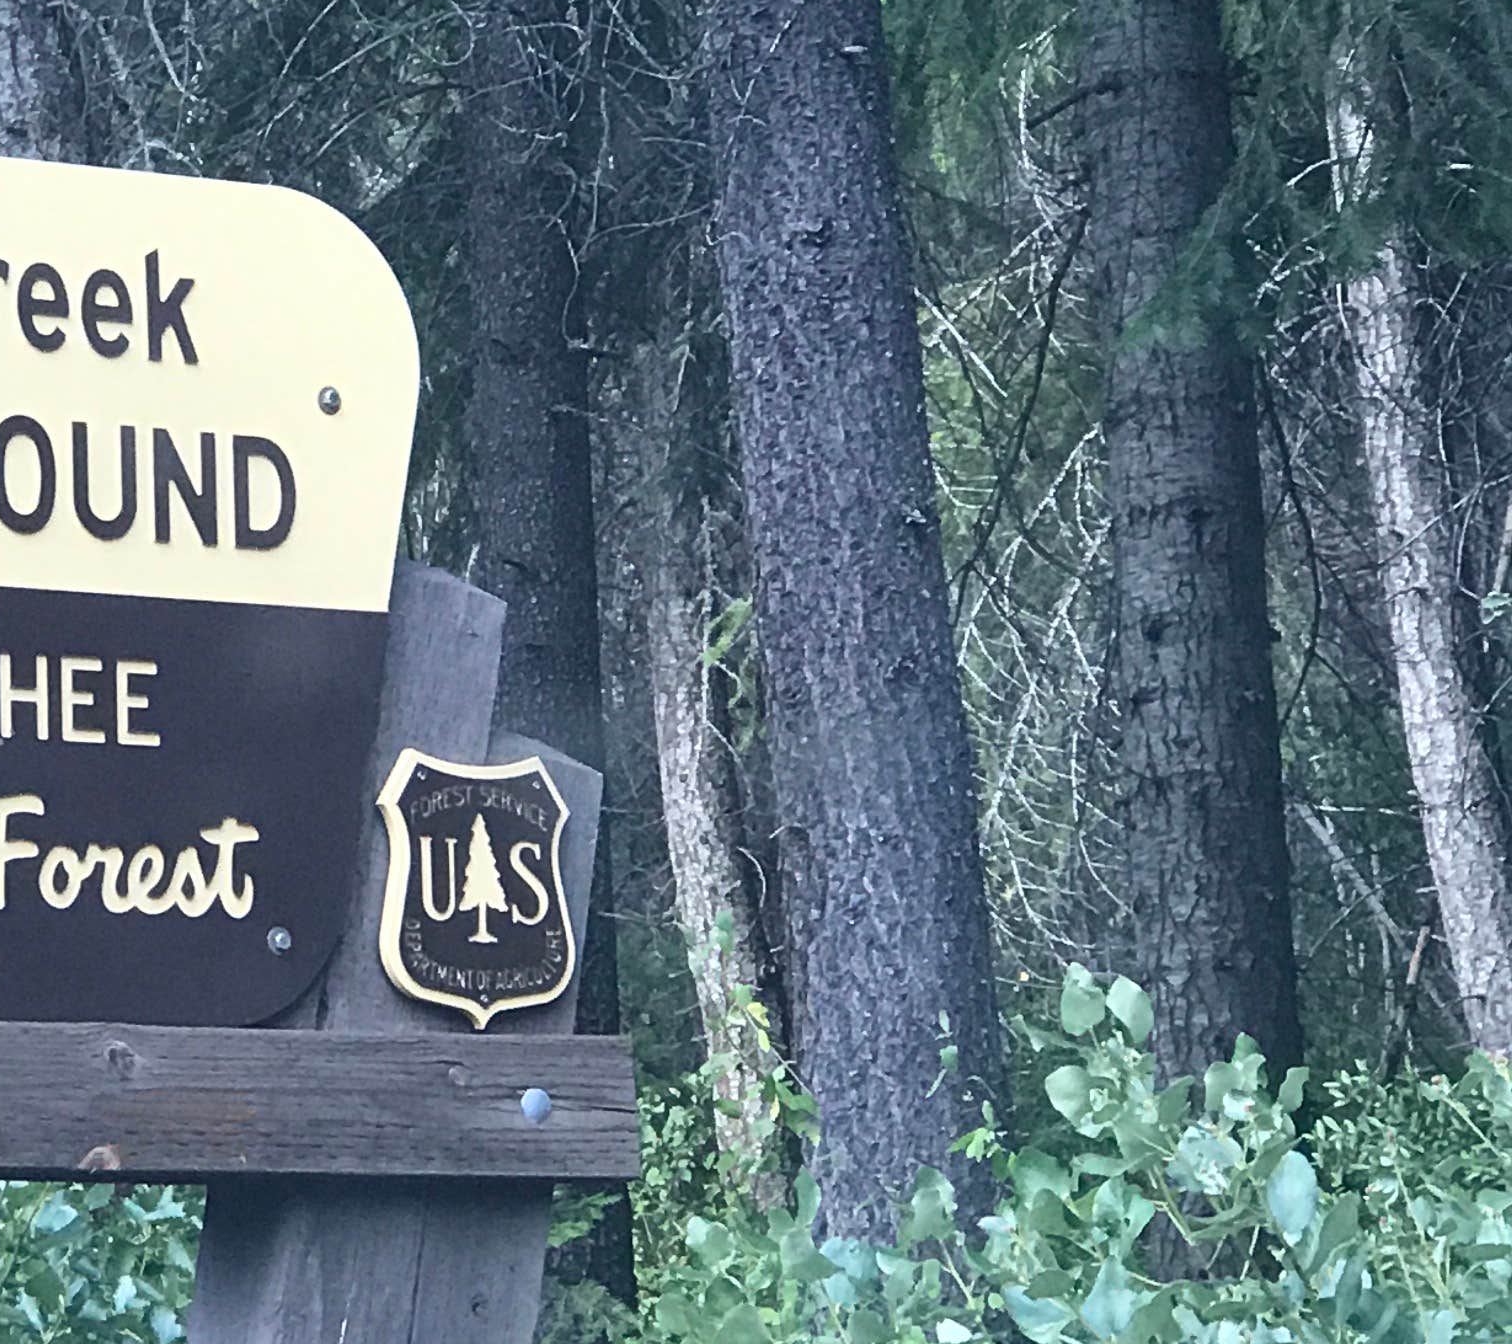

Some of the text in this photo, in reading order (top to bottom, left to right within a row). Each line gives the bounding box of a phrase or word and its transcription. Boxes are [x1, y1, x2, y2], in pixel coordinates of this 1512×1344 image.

[409, 783, 548, 832] FOREST SERVICE
[405, 919, 474, 990] DEPARTMENT
[495, 927, 563, 991] AGRICULTURE
